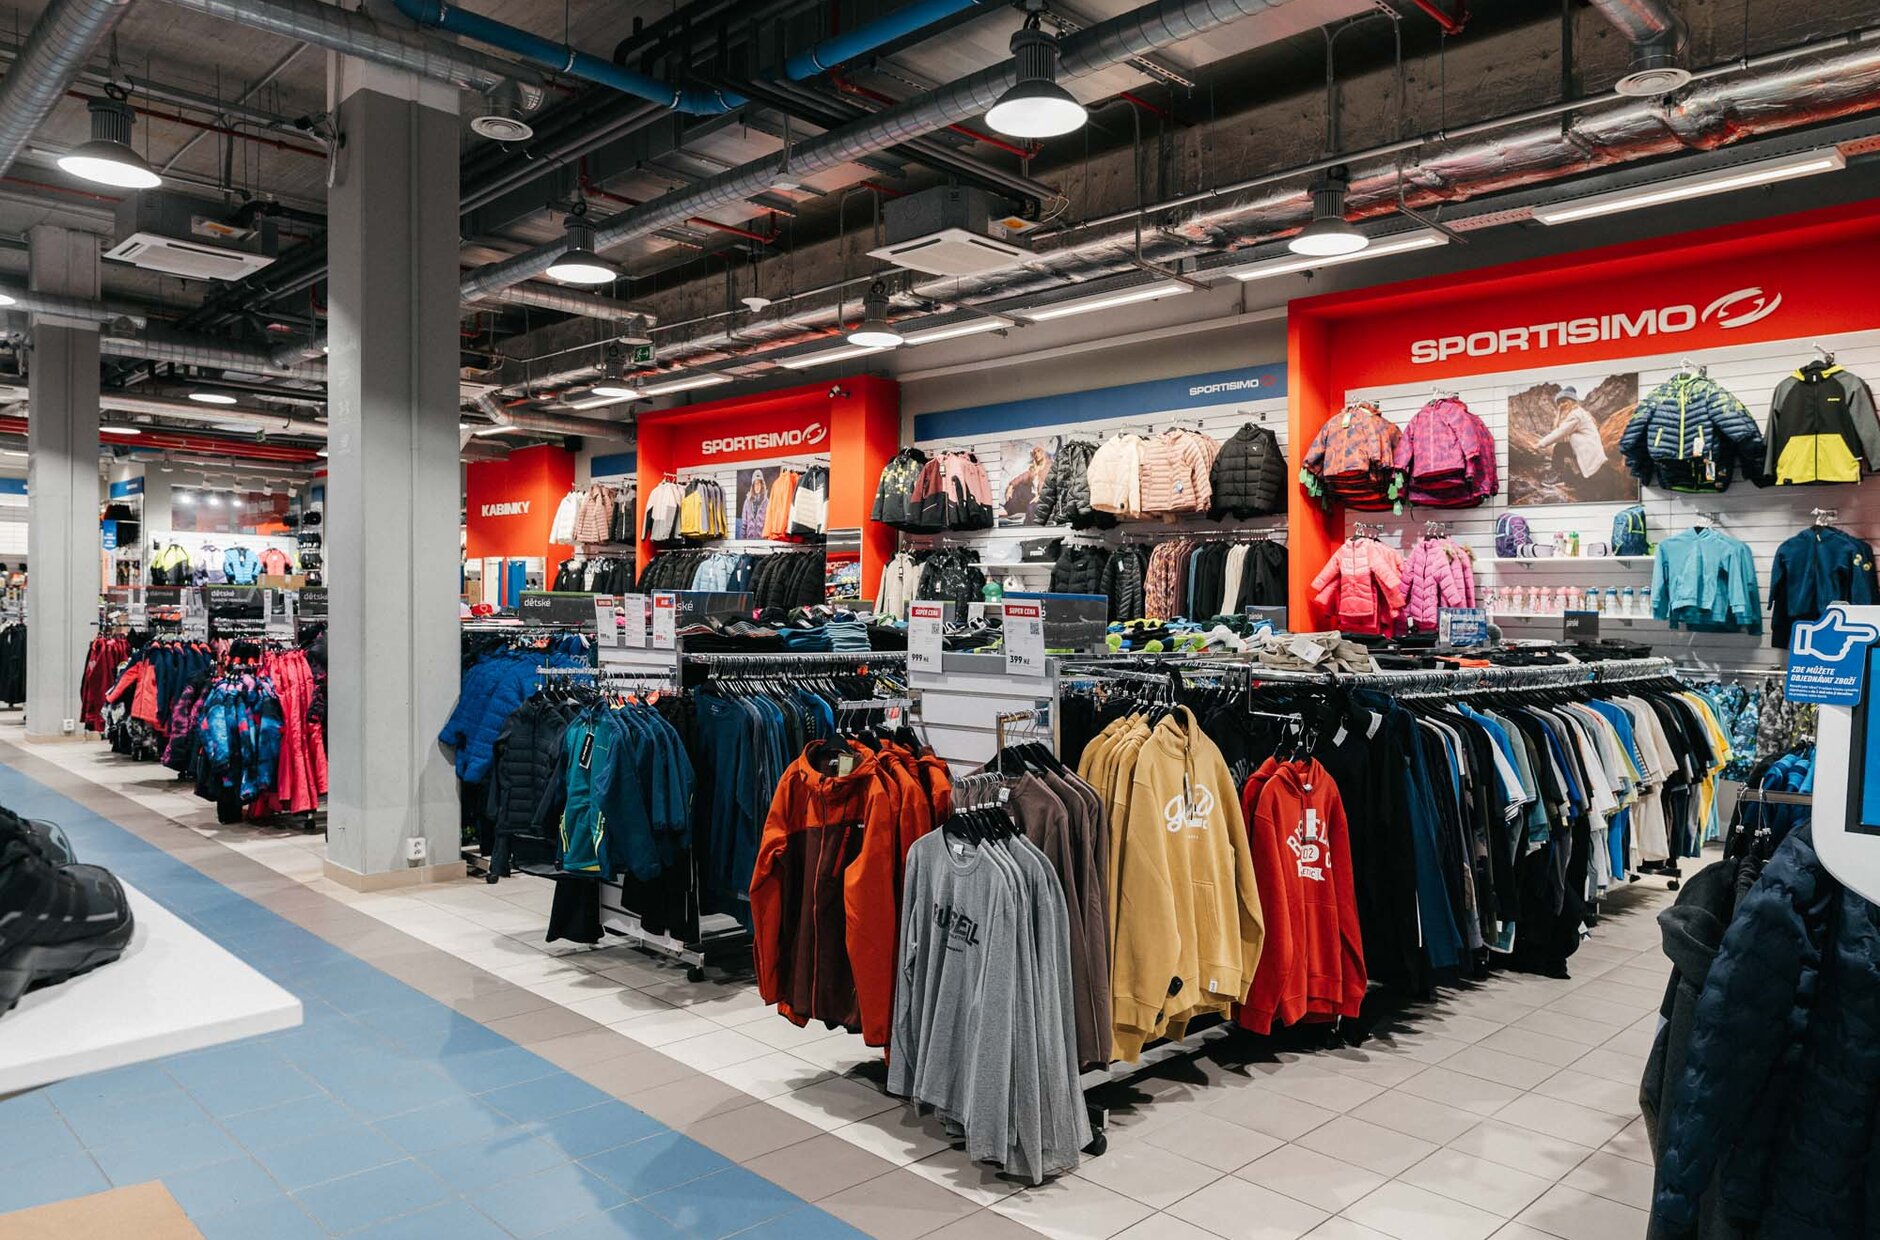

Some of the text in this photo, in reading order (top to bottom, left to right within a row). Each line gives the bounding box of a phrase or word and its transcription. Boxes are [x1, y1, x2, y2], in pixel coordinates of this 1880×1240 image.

[1410, 303, 1697, 365] SPORTISIMO
[1189, 378, 1260, 397] SPORTISIMO
[701, 429, 802, 455] SPORTISIMO
[481, 500, 531, 517] KABINKY
[524, 598, 552, 607] dětské
[915, 608, 928, 616] SUPER
[1009, 607, 1024, 615] SUPER
[1024, 608, 1036, 616] CENA
[911, 653, 923, 662] 999
[1009, 655, 1023, 664] 399
[1806, 665, 1836, 675] MŮŽETE
[1790, 674, 1856, 685] OBJEDNÁVAT ZBOŽÍ
